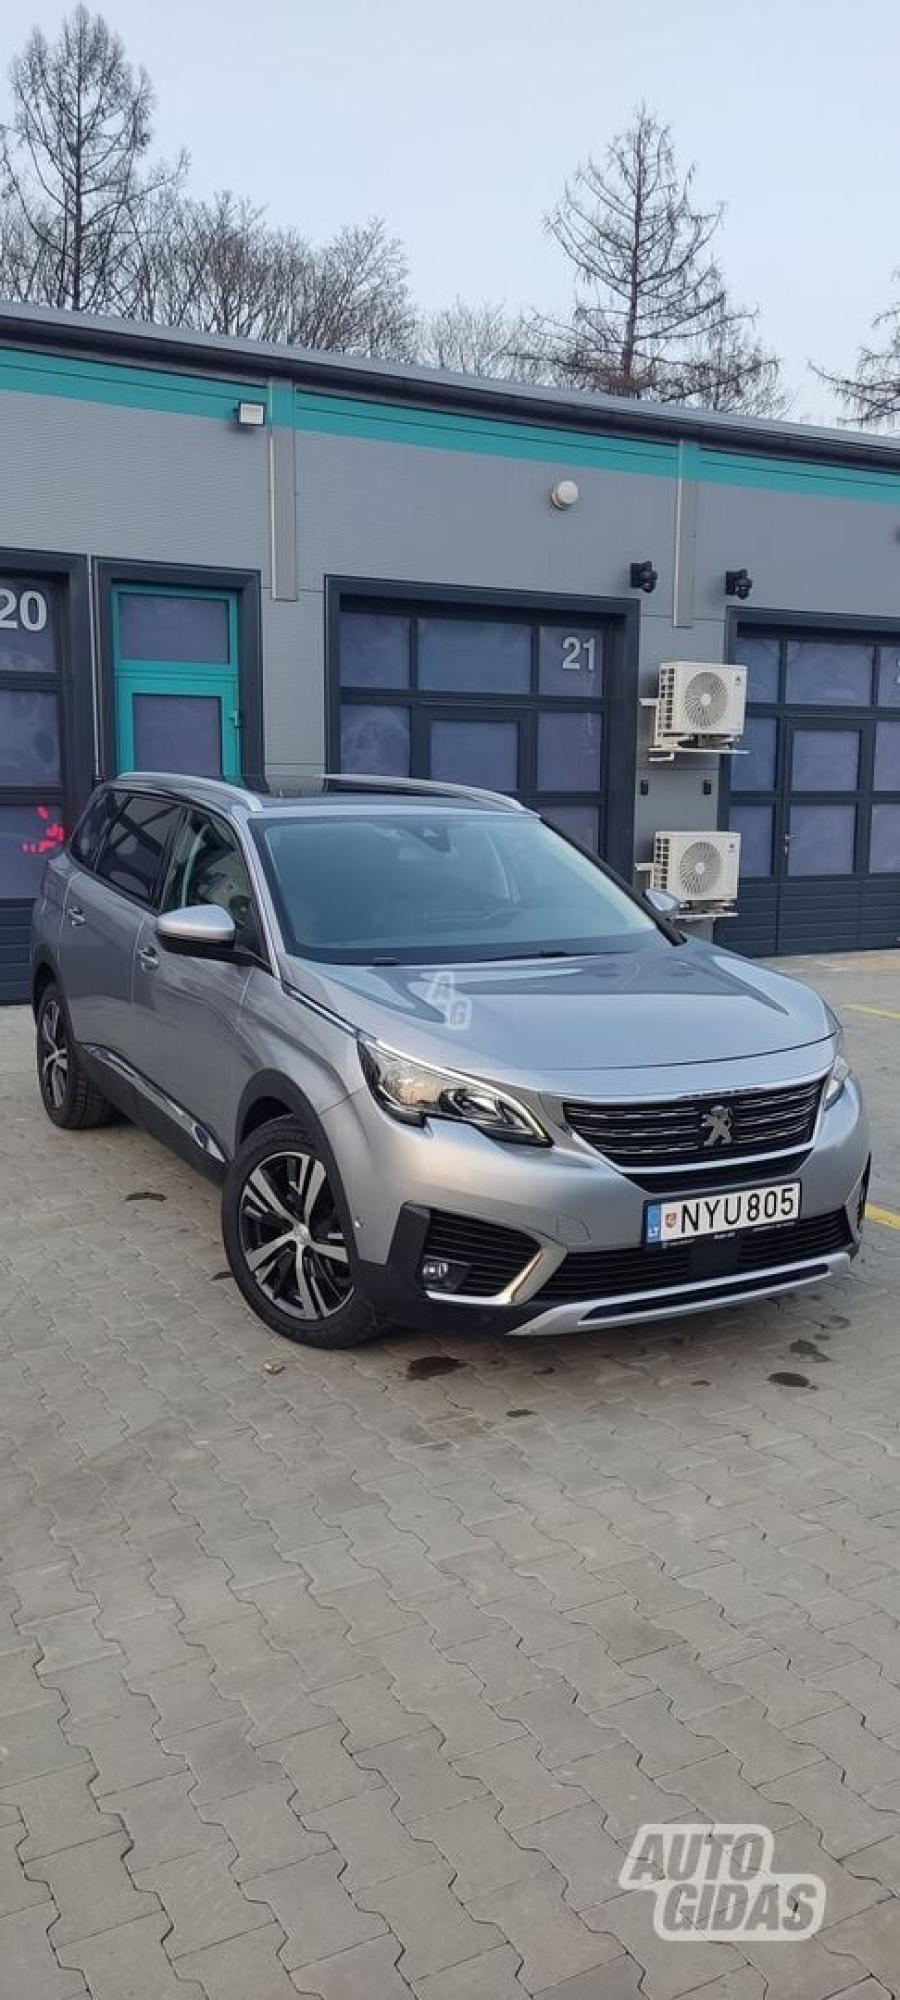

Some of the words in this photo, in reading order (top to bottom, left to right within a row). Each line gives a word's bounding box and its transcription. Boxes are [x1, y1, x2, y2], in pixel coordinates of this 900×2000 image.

[0, 589, 47, 631] 20
[562, 637, 595, 670] 21
[681, 1187, 794, 1234] NYU805
